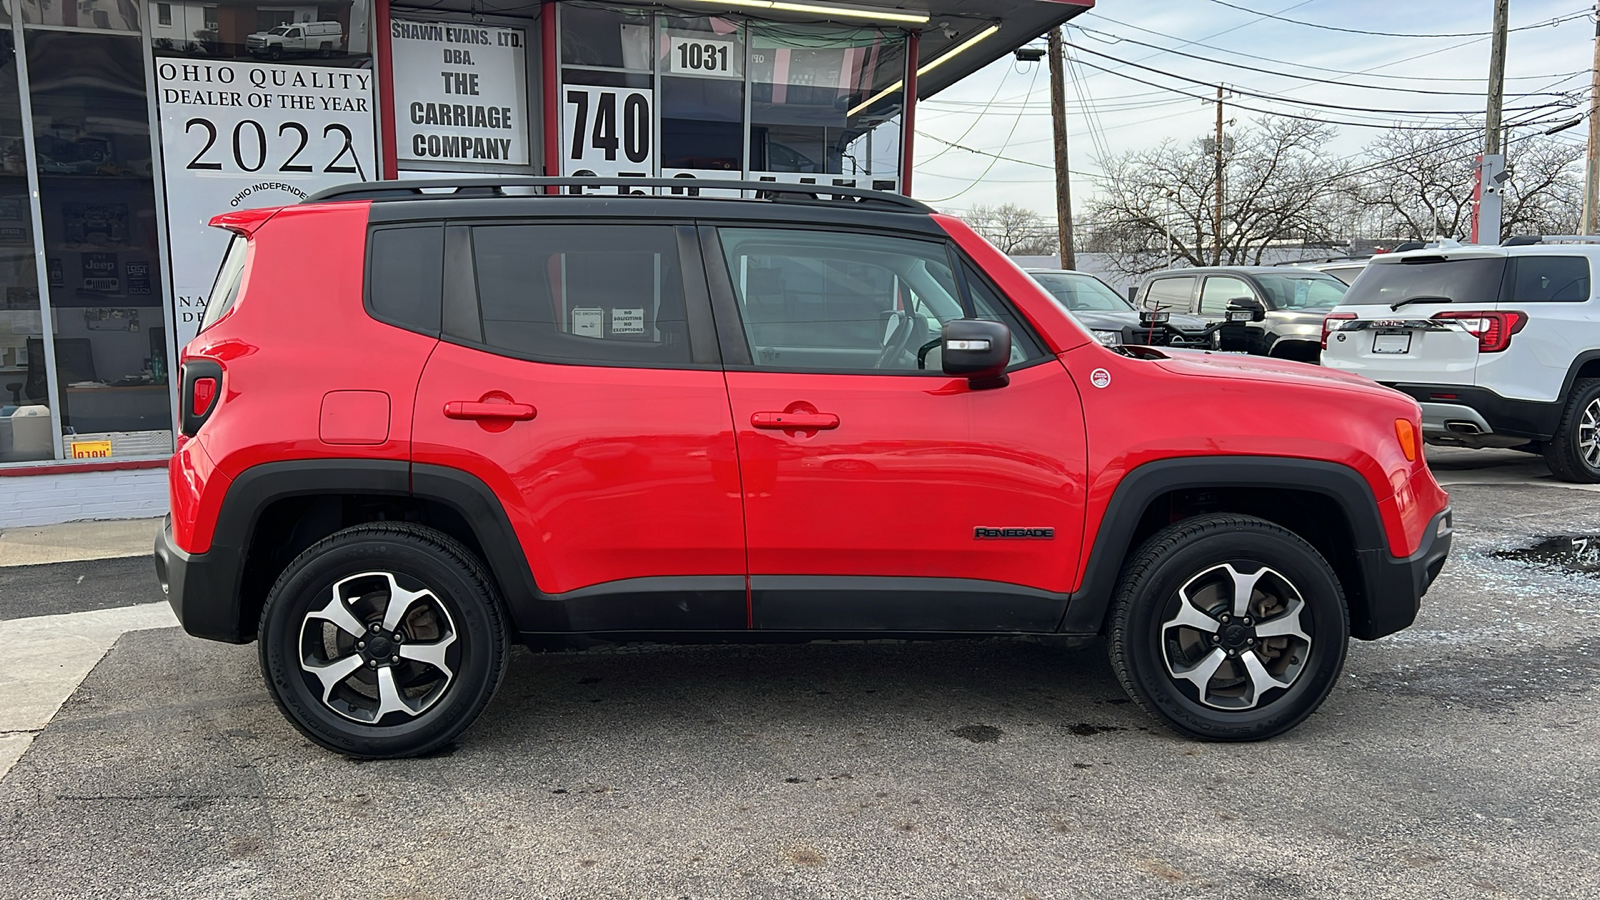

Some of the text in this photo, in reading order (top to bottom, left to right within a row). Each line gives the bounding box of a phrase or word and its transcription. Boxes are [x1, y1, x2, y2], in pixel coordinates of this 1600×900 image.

[391, 23, 523, 48] SHAWN EVANS. LTD.
[443, 48, 475, 65] DBA.
[677, 43, 728, 71] 1031
[159, 63, 372, 91] OHIO QUALITY
[441, 71, 480, 96] THE
[164, 88, 369, 113] DEALER OF THE YEAR
[410, 101, 512, 129] CARRIAGE
[567, 90, 650, 164] 740
[184, 118, 358, 174] 2022
[412, 133, 512, 160] COMPANY
[230, 182, 309, 207] OHIO INDEPENDE
[85, 259, 115, 271] Jeep
[974, 527, 1054, 538] RENEGADE
